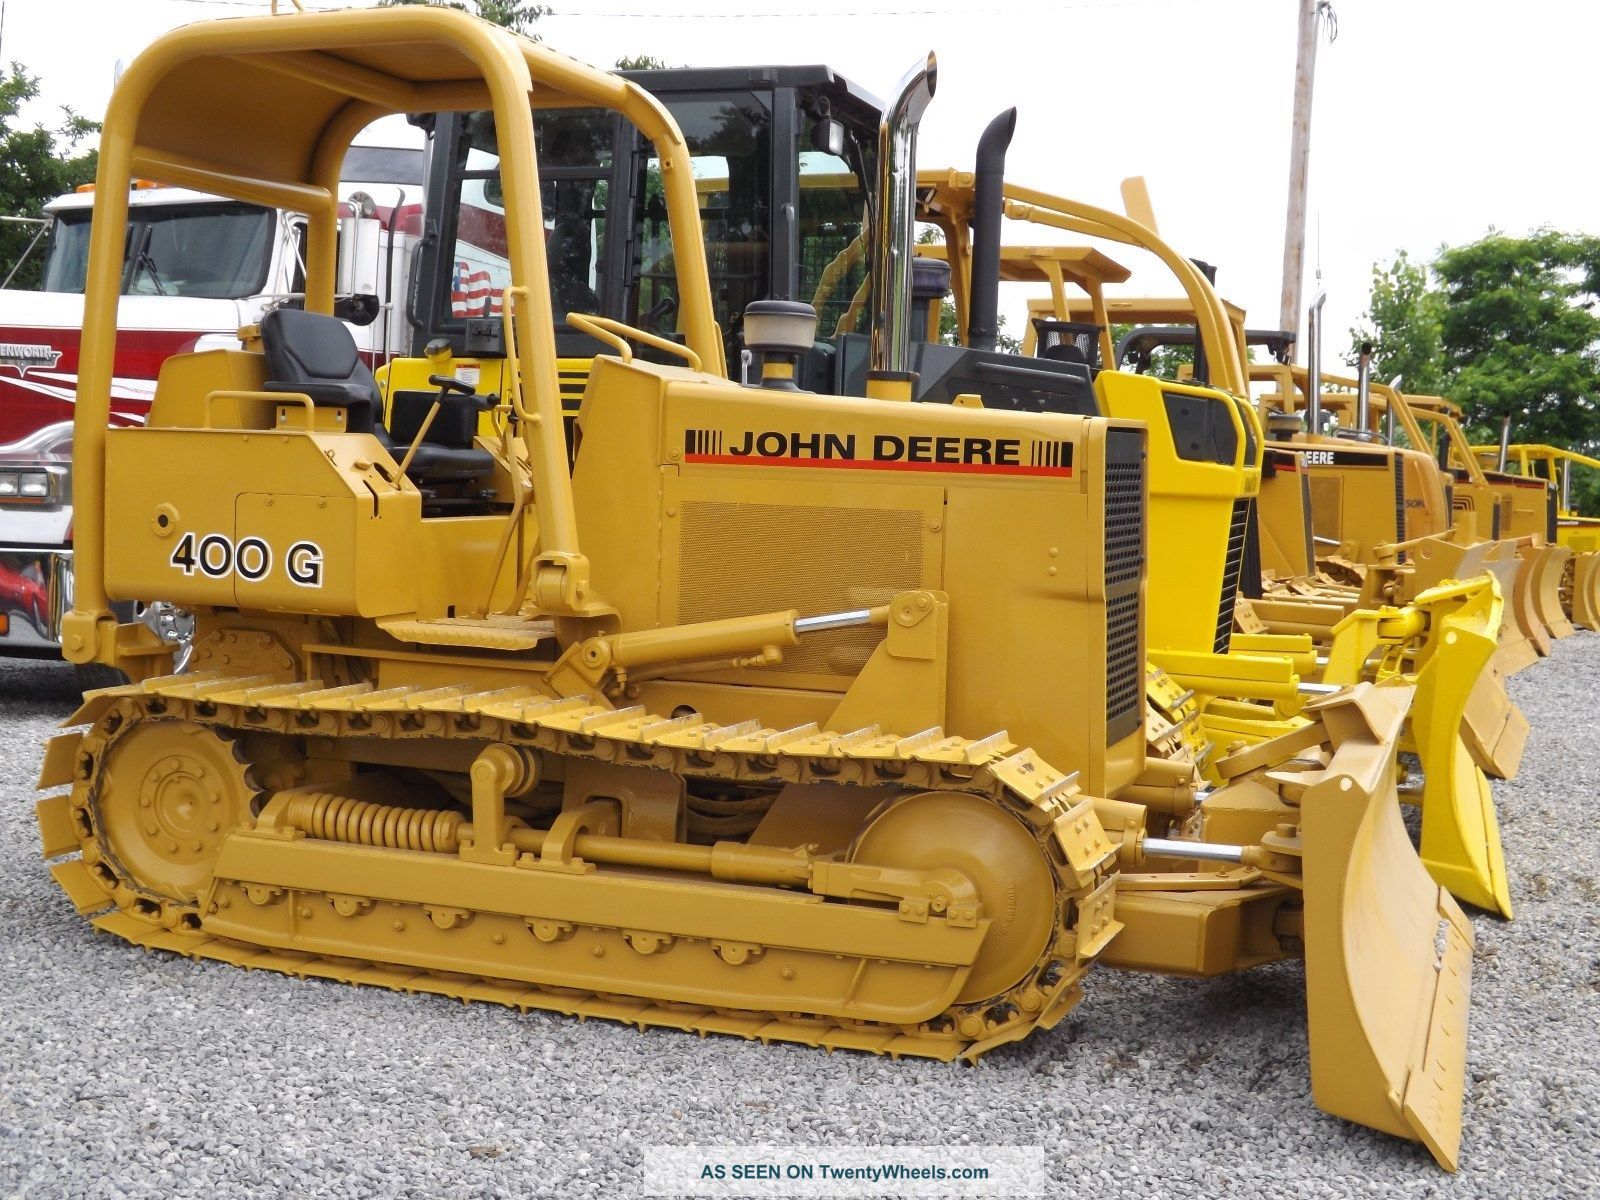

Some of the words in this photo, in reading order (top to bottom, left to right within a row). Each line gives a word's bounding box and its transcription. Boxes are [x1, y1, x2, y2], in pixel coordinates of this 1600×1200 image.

[0, 345, 51, 358] ENWORTH
[729, 431, 856, 460] JOHN
[873, 434, 1021, 466] DEERE
[170, 532, 273, 582] 400
[285, 540, 324, 588] G
